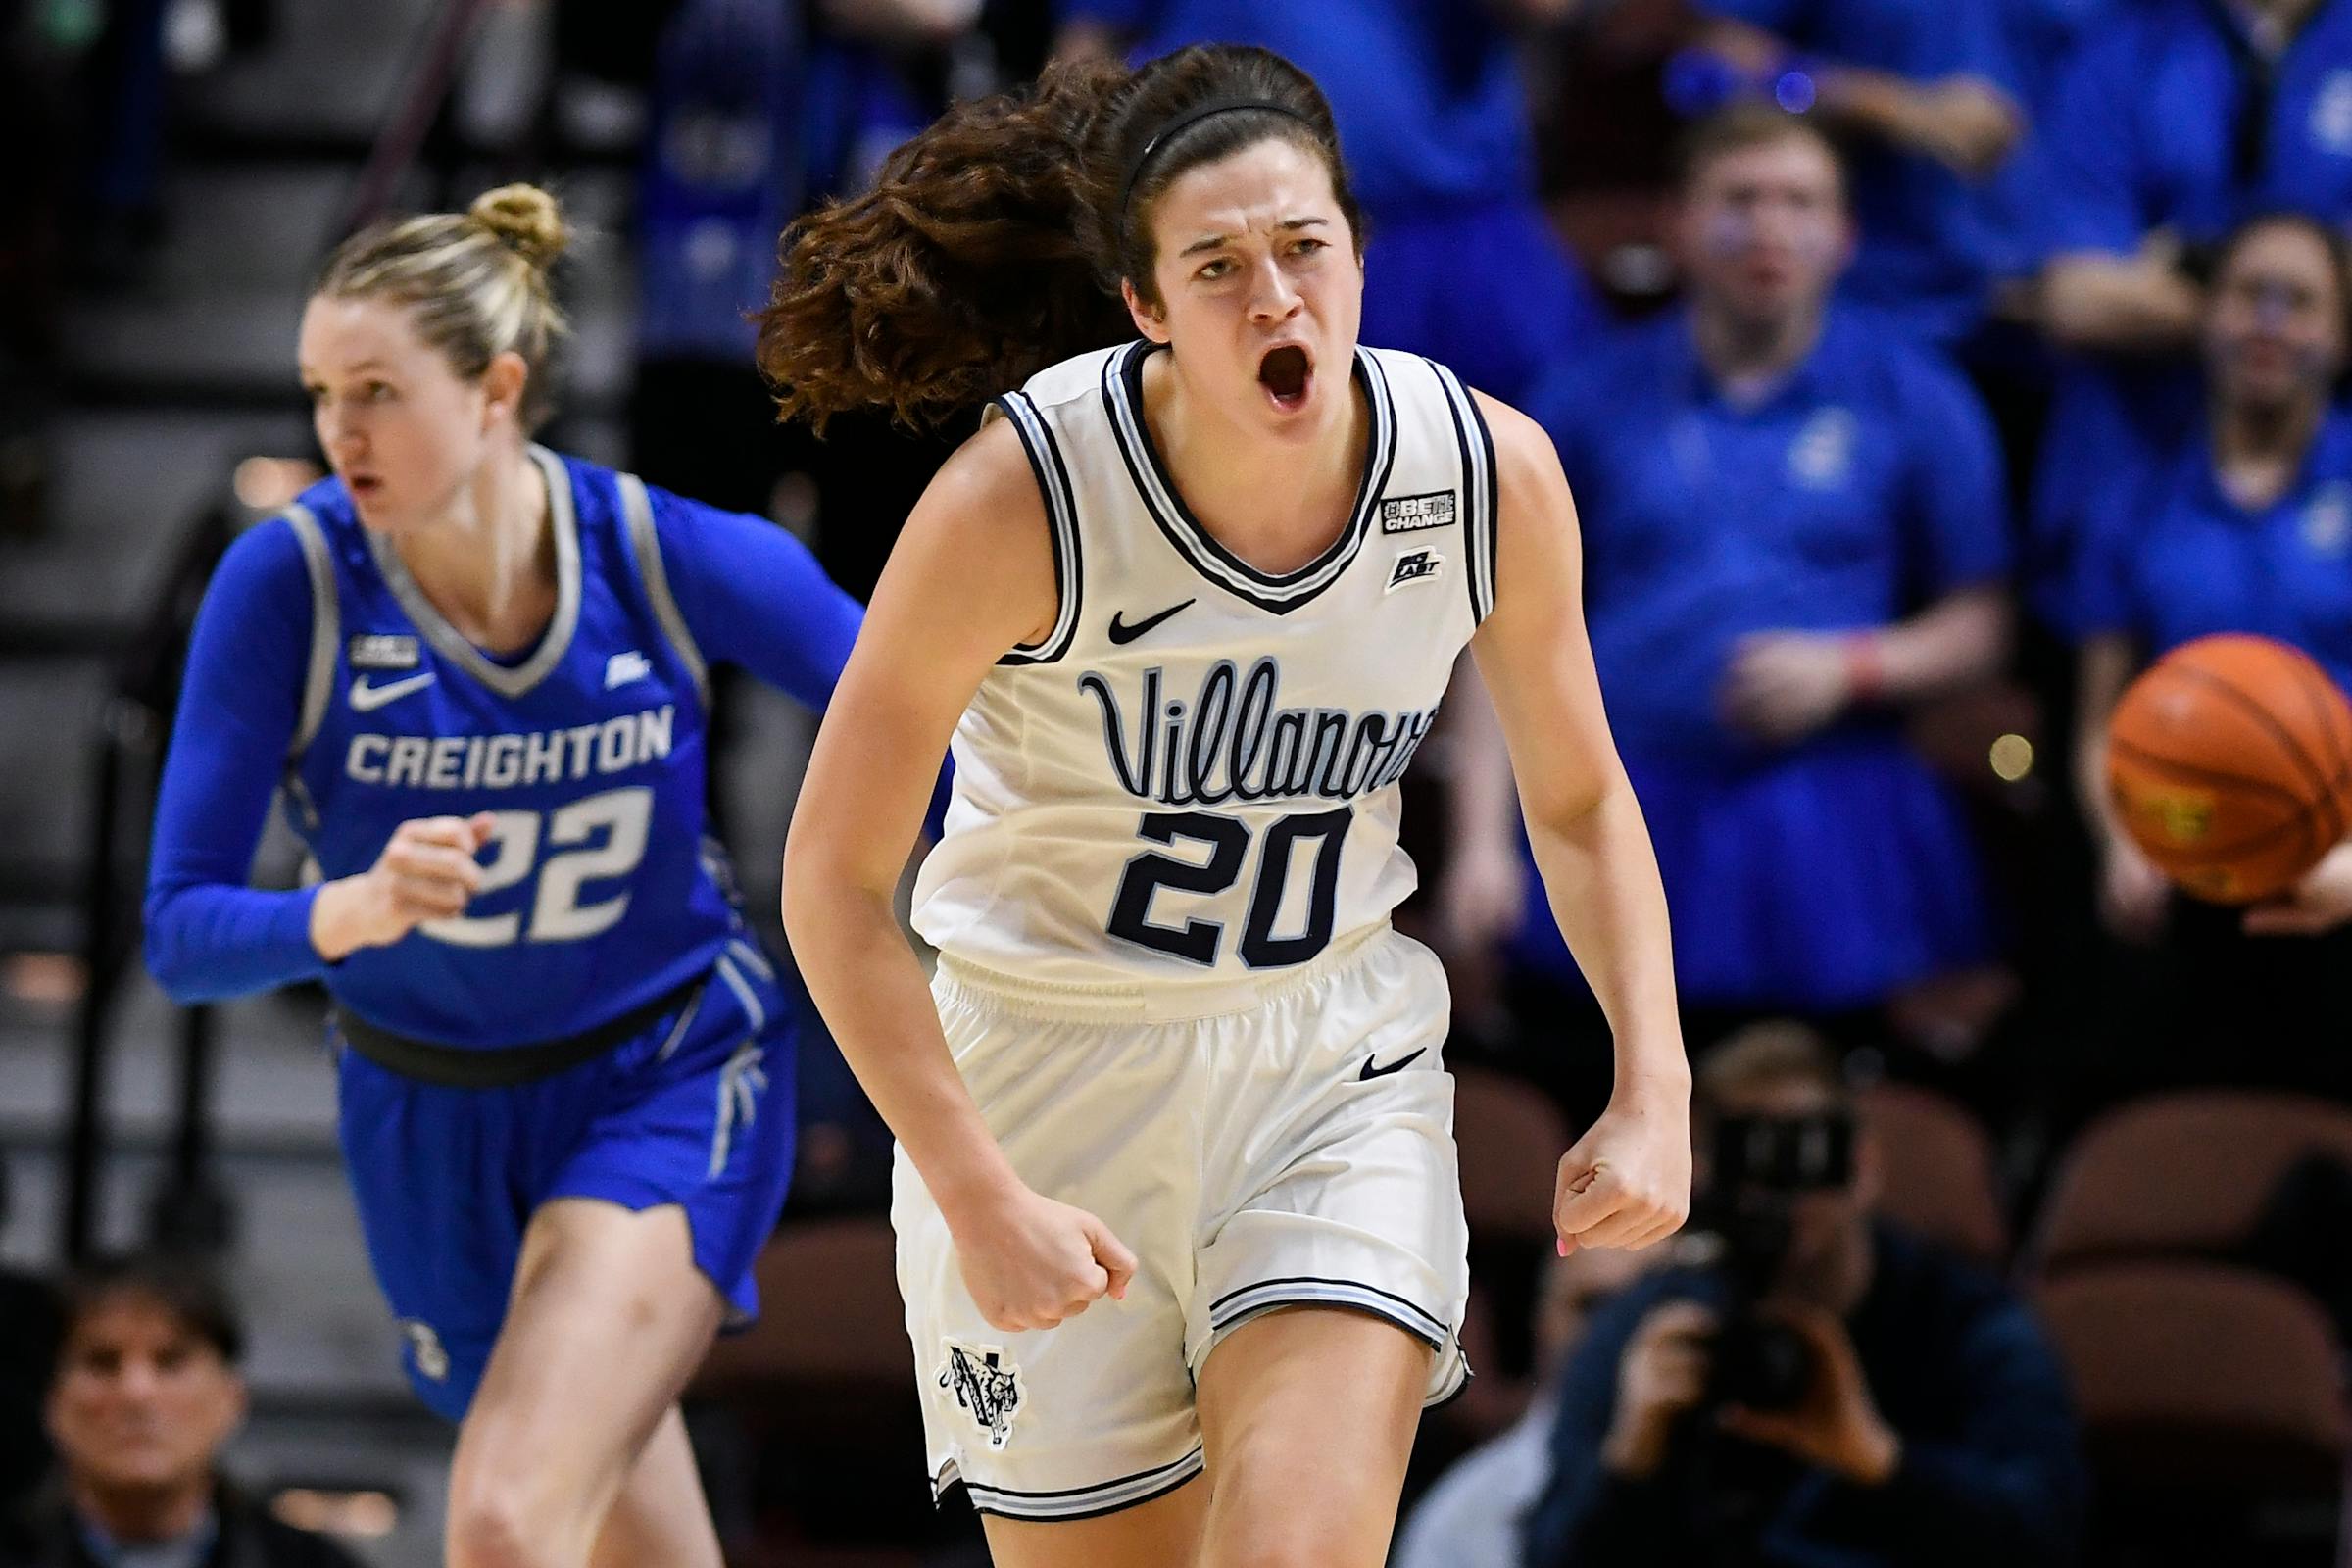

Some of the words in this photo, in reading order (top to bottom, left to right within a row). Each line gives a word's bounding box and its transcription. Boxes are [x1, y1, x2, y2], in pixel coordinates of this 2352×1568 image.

[1385, 511, 1453, 531] CHANGE
[346, 704, 675, 788] CREIGHTON
[416, 786, 654, 947] 22
[1106, 806, 1354, 970] 20
